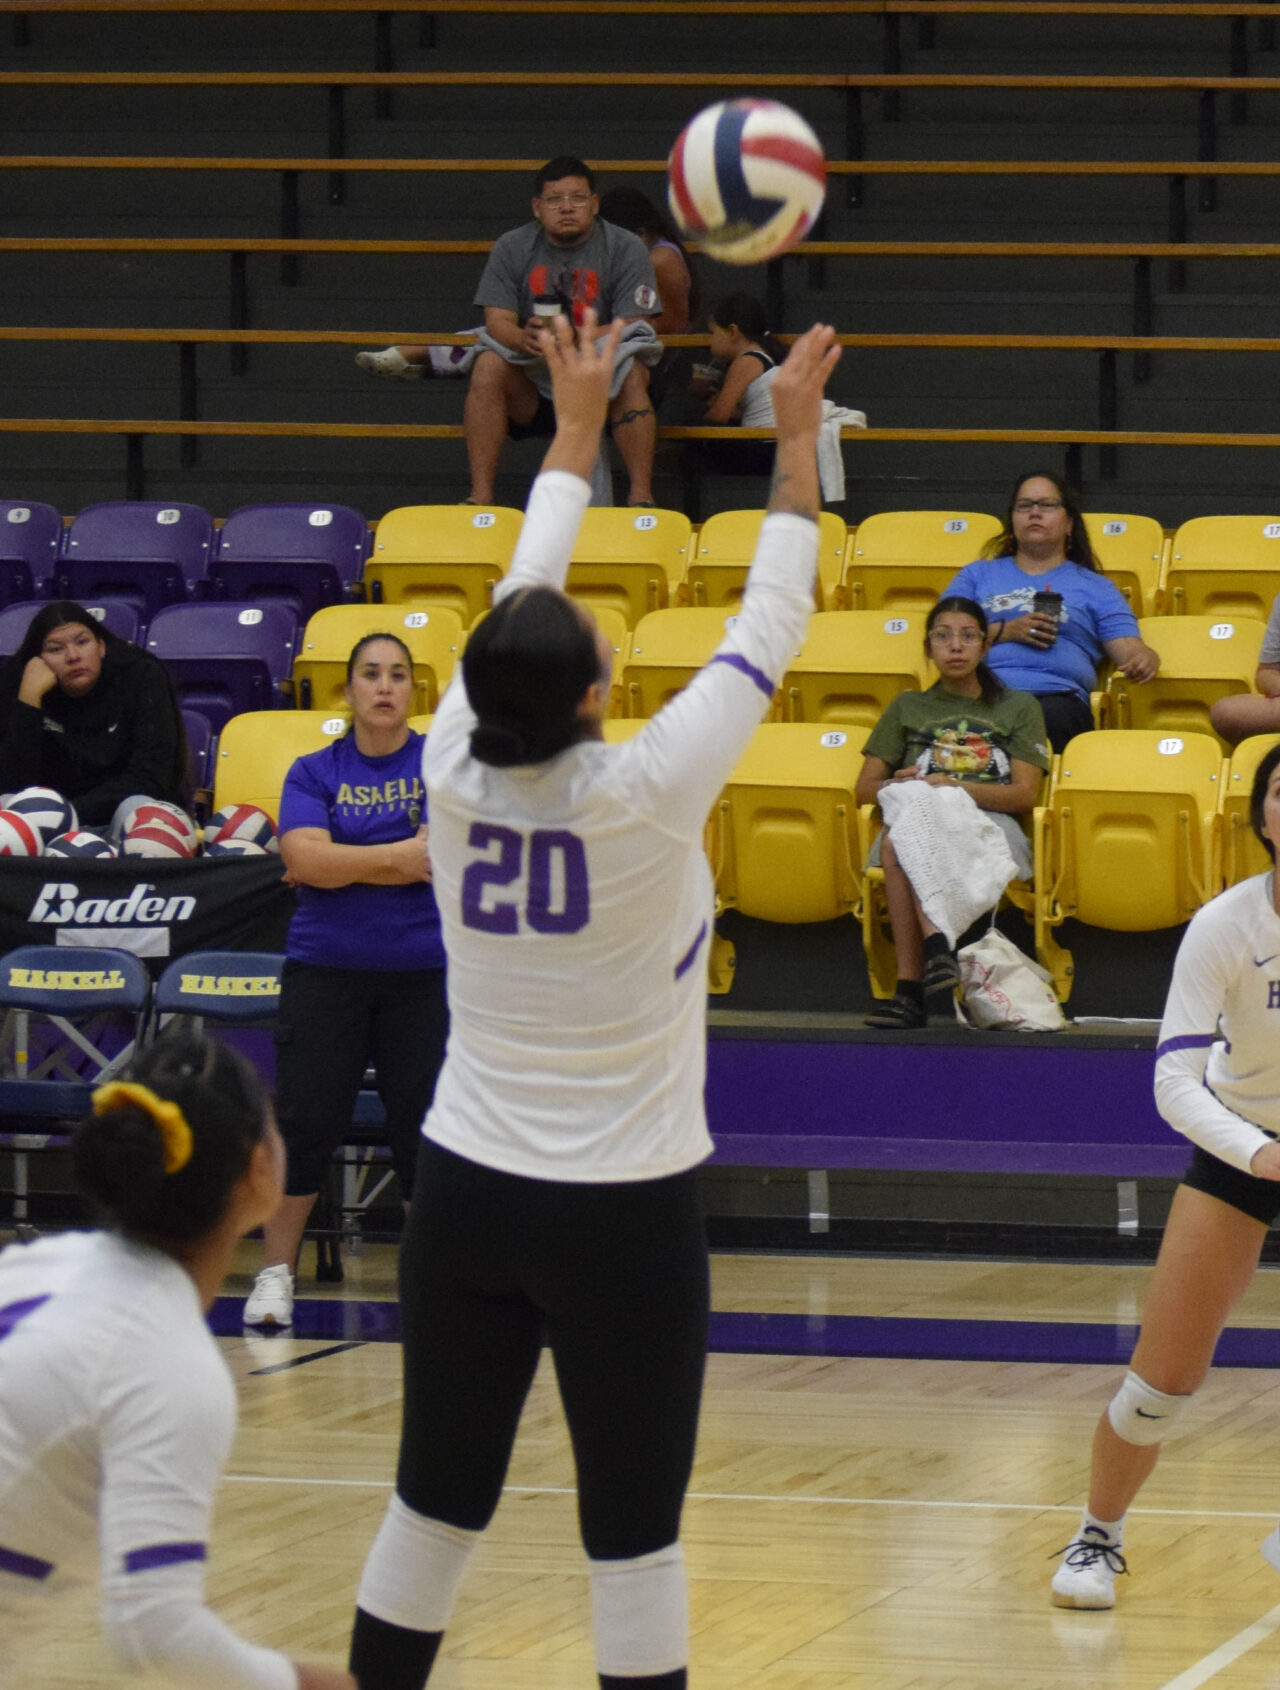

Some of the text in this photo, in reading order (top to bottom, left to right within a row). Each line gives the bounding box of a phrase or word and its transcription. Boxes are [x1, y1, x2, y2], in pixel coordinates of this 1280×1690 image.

[336, 777, 424, 806] ASKELL
[460, 821, 591, 936] 20
[27, 883, 197, 924] Baden
[8, 967, 126, 991] HASKELL
[179, 974, 282, 997] HASKEL
